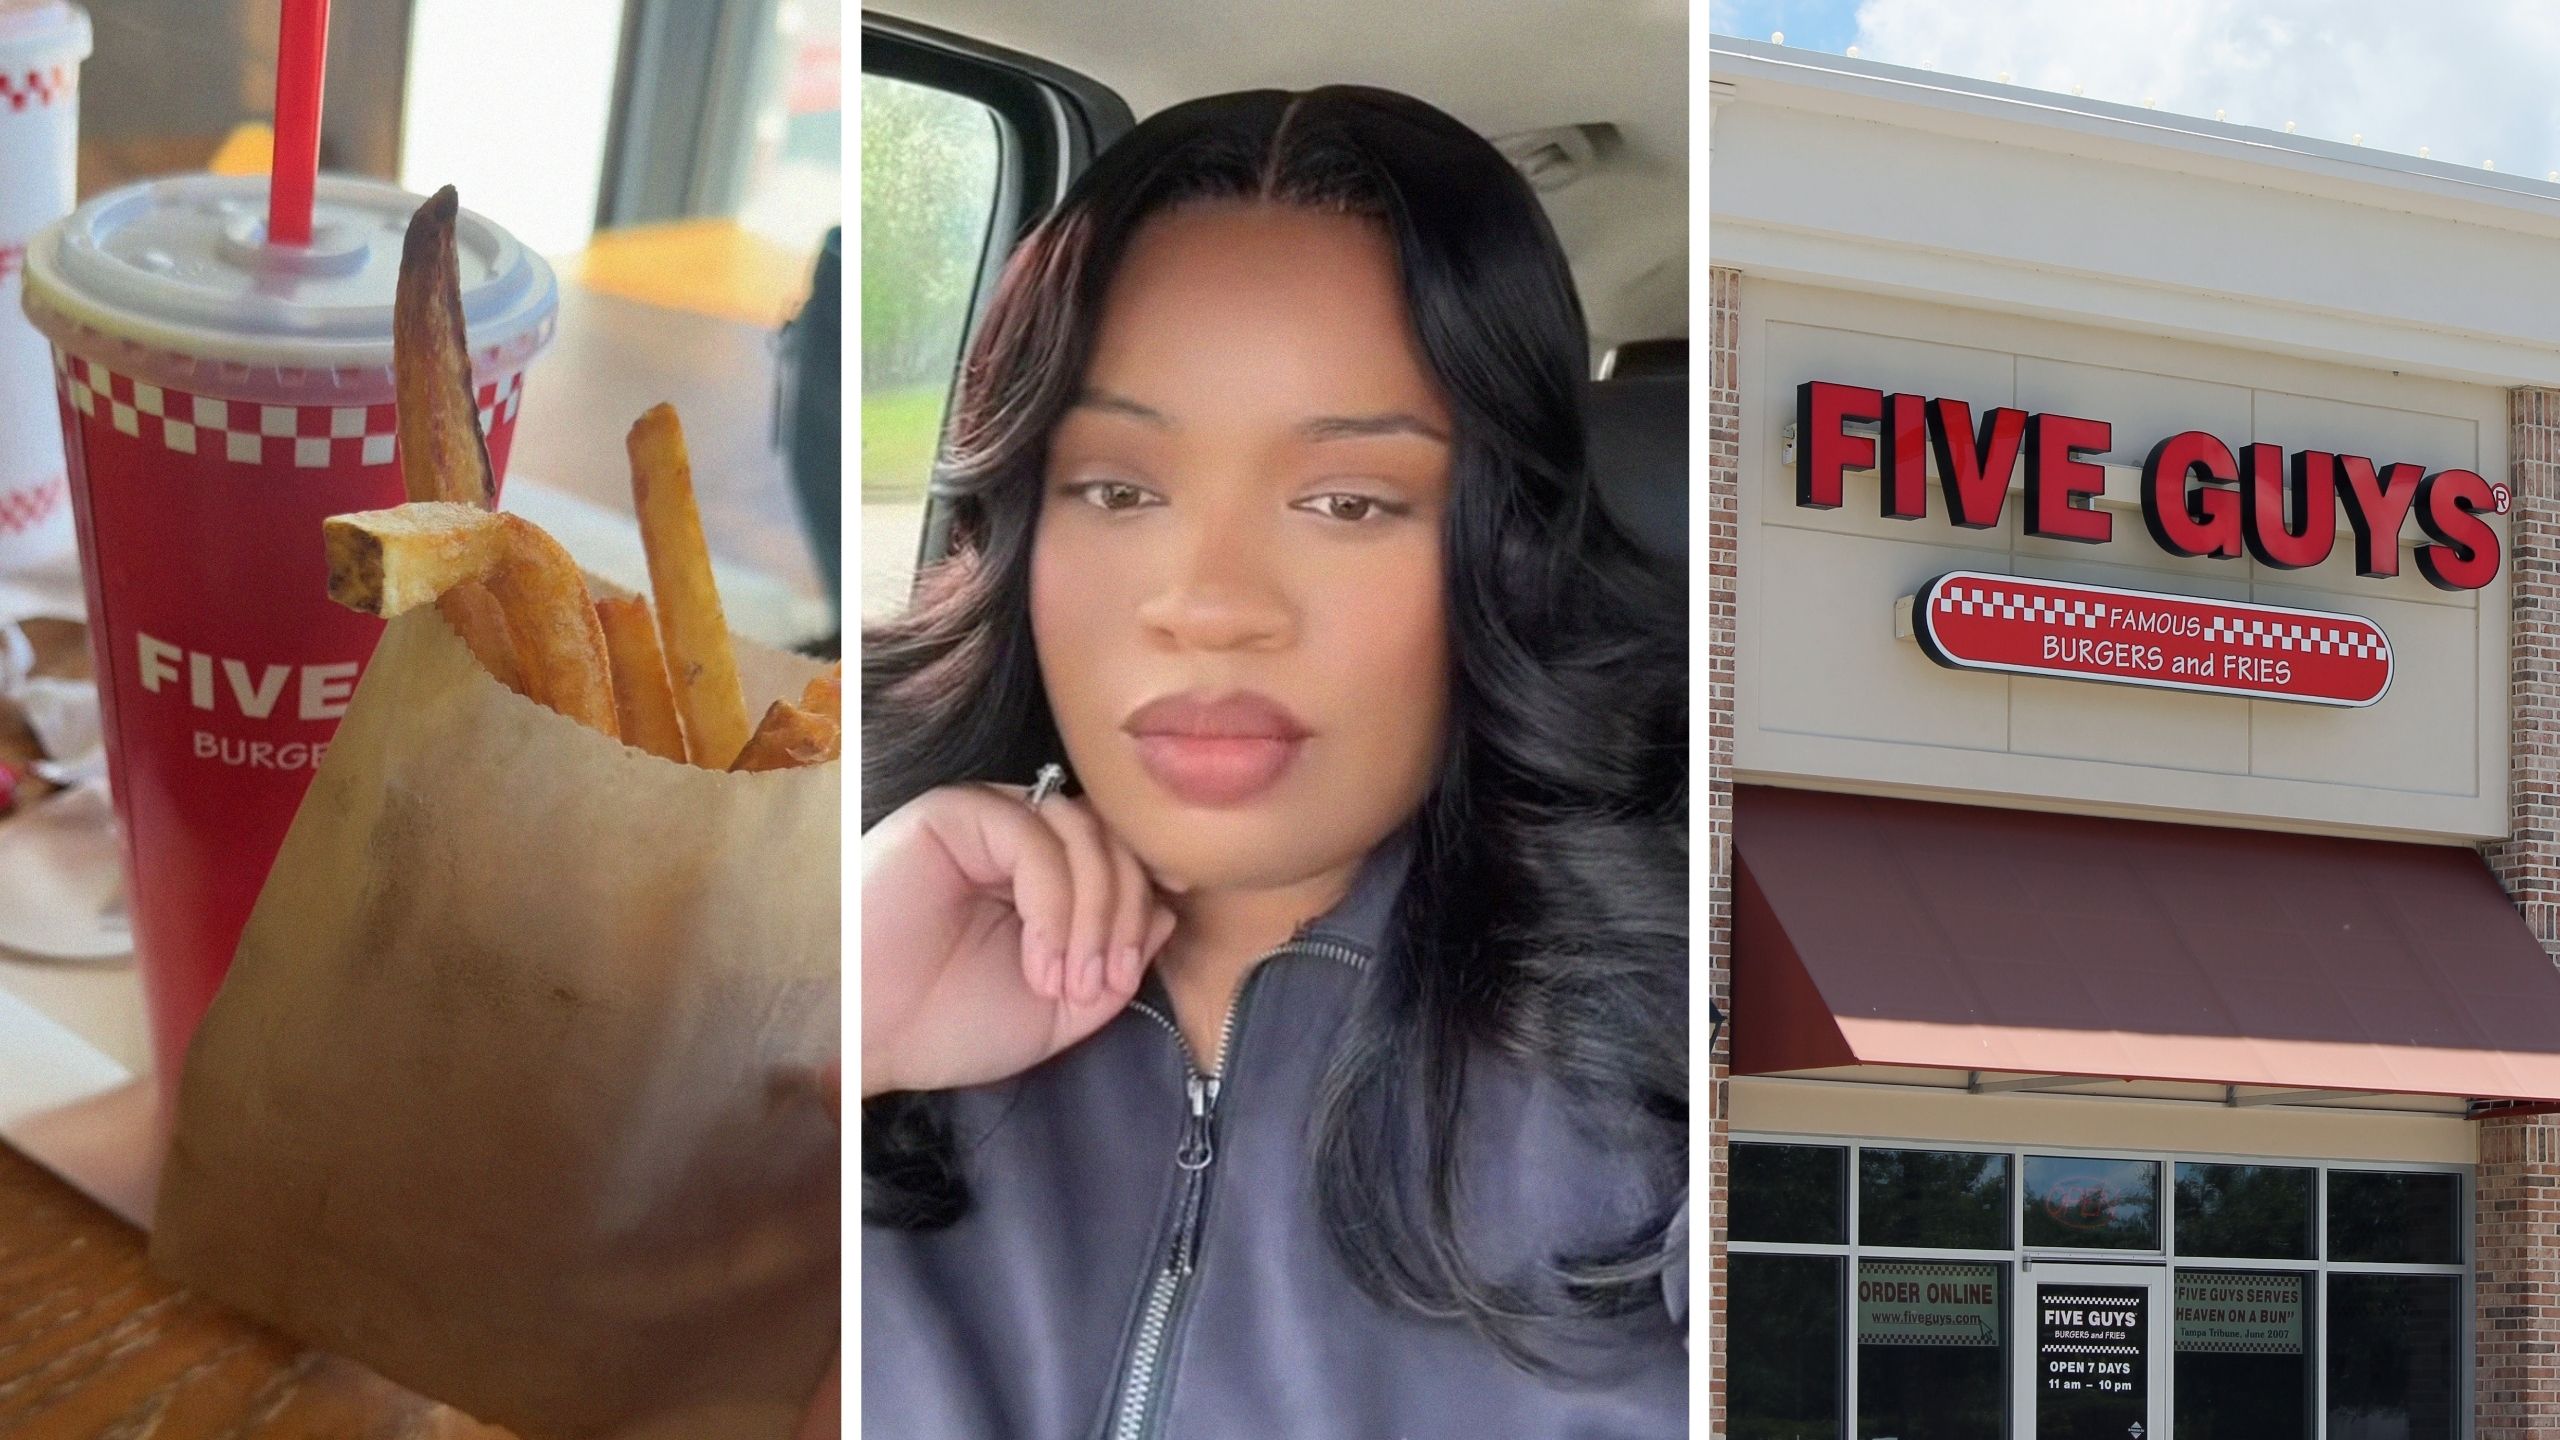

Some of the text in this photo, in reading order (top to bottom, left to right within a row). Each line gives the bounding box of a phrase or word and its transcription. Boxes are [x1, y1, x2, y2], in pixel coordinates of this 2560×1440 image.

[1796, 381, 2112, 544] FIVE
[2109, 608, 2201, 638] FAMOUS
[2043, 635, 2291, 685] BURGERS and FRIES
[137, 631, 359, 720] FIVE
[1859, 1280, 1993, 1305] ORDER ONLINE
[2210, 1287, 2244, 1302] GUYS
[2246, 1289, 2299, 1304] SERVES
[1872, 1310, 1981, 1327] www.fiveguys.com
[2044, 1309, 2084, 1326] FIVE
[2175, 1307, 2225, 1322] HEAVEN
[2228, 1309, 2246, 1323] ON
[2248, 1310, 2257, 1323] A
[2054, 1330, 2126, 1340] BURGERS and FRIES
[2180, 1327, 2289, 1339] Tampa Tribune, June 2007
[2049, 1361, 2131, 1374] OPEN 7 DAYS
[2048, 1378, 2060, 1389] 11
[2063, 1380, 2081, 1390] am
[2099, 1379, 2112, 1390] 10
[2114, 1381, 2132, 1392] pm
